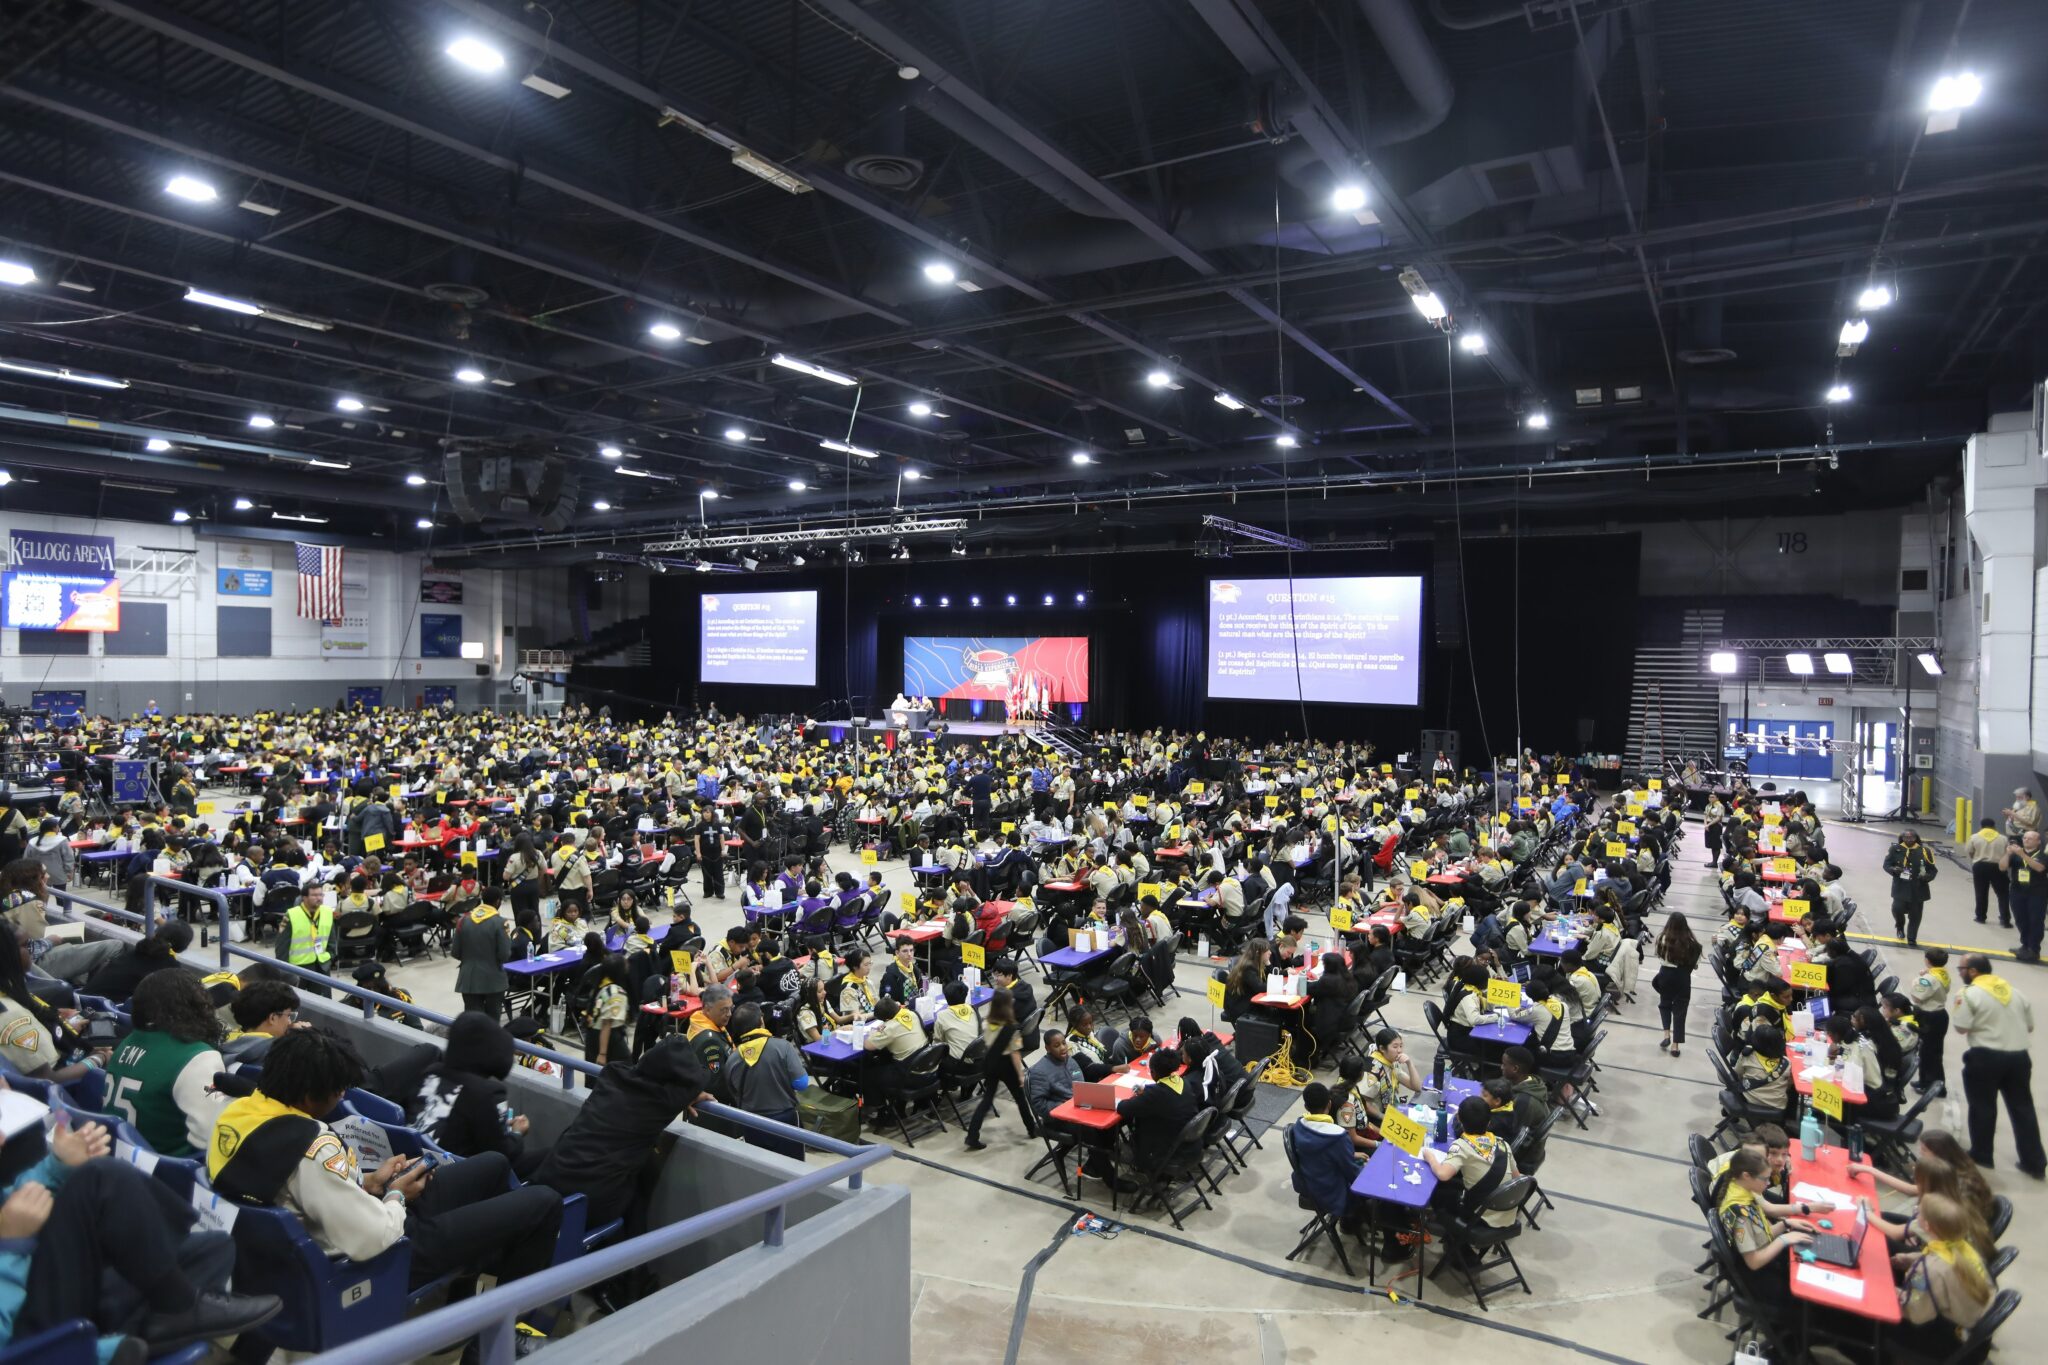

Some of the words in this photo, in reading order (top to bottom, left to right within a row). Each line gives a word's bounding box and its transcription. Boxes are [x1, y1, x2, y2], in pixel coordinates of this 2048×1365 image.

[9, 536, 71, 565] KELLOGG
[73, 543, 115, 571] ARENA
[1266, 593, 1317, 604] QUESTION
[1288, 613, 1325, 621] Crinthians
[1317, 652, 1342, 660] hombre
[1343, 653, 1367, 661] natural
[1369, 653, 1377, 661] no
[1379, 653, 1404, 661] percibe
[1333, 914, 1346, 925] 36G
[967, 951, 981, 961] 47H
[677, 958, 689, 967] 57H
[1794, 970, 1822, 981] 226G
[1208, 987, 1219, 999] 37H
[1491, 988, 1517, 1000] 225F
[118, 1045, 147, 1067] EMY
[1815, 1089, 1839, 1109] 227H
[1387, 1118, 1418, 1143] 235F
[351, 1286, 362, 1301] B
